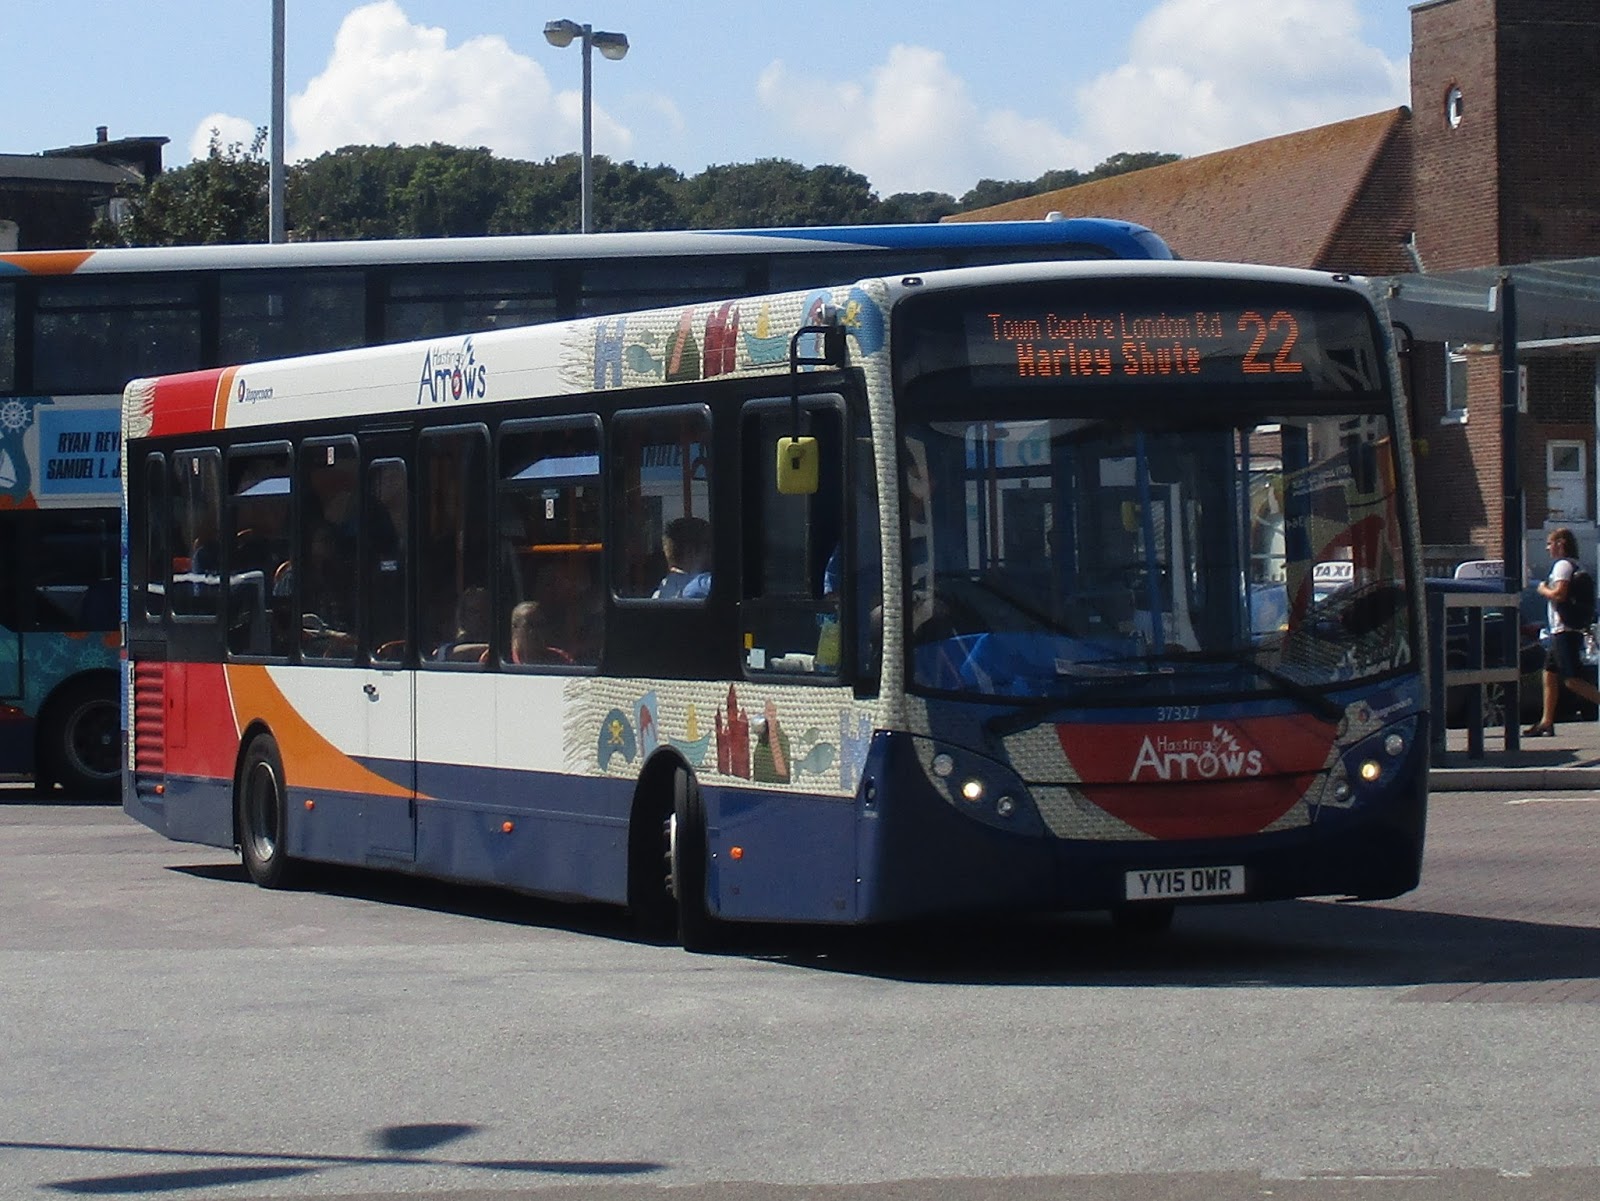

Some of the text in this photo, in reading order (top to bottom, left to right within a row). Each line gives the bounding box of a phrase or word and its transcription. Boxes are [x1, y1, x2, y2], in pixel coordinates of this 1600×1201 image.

[987, 311, 1223, 341] Town Centre London Rd
[1237, 310, 1302, 374] 22
[1016, 341, 1201, 377] Harley Shute
[417, 348, 486, 405] Arrows
[58, 432, 91, 453] RYAN
[46, 458, 94, 480] SAMUEL
[98, 458, 108, 478] L.
[1314, 565, 1352, 577] TAXI
[1157, 705, 1200, 721] 37327
[1130, 735, 1263, 782] Arrows
[1139, 868, 1232, 894] YY15 OWR
